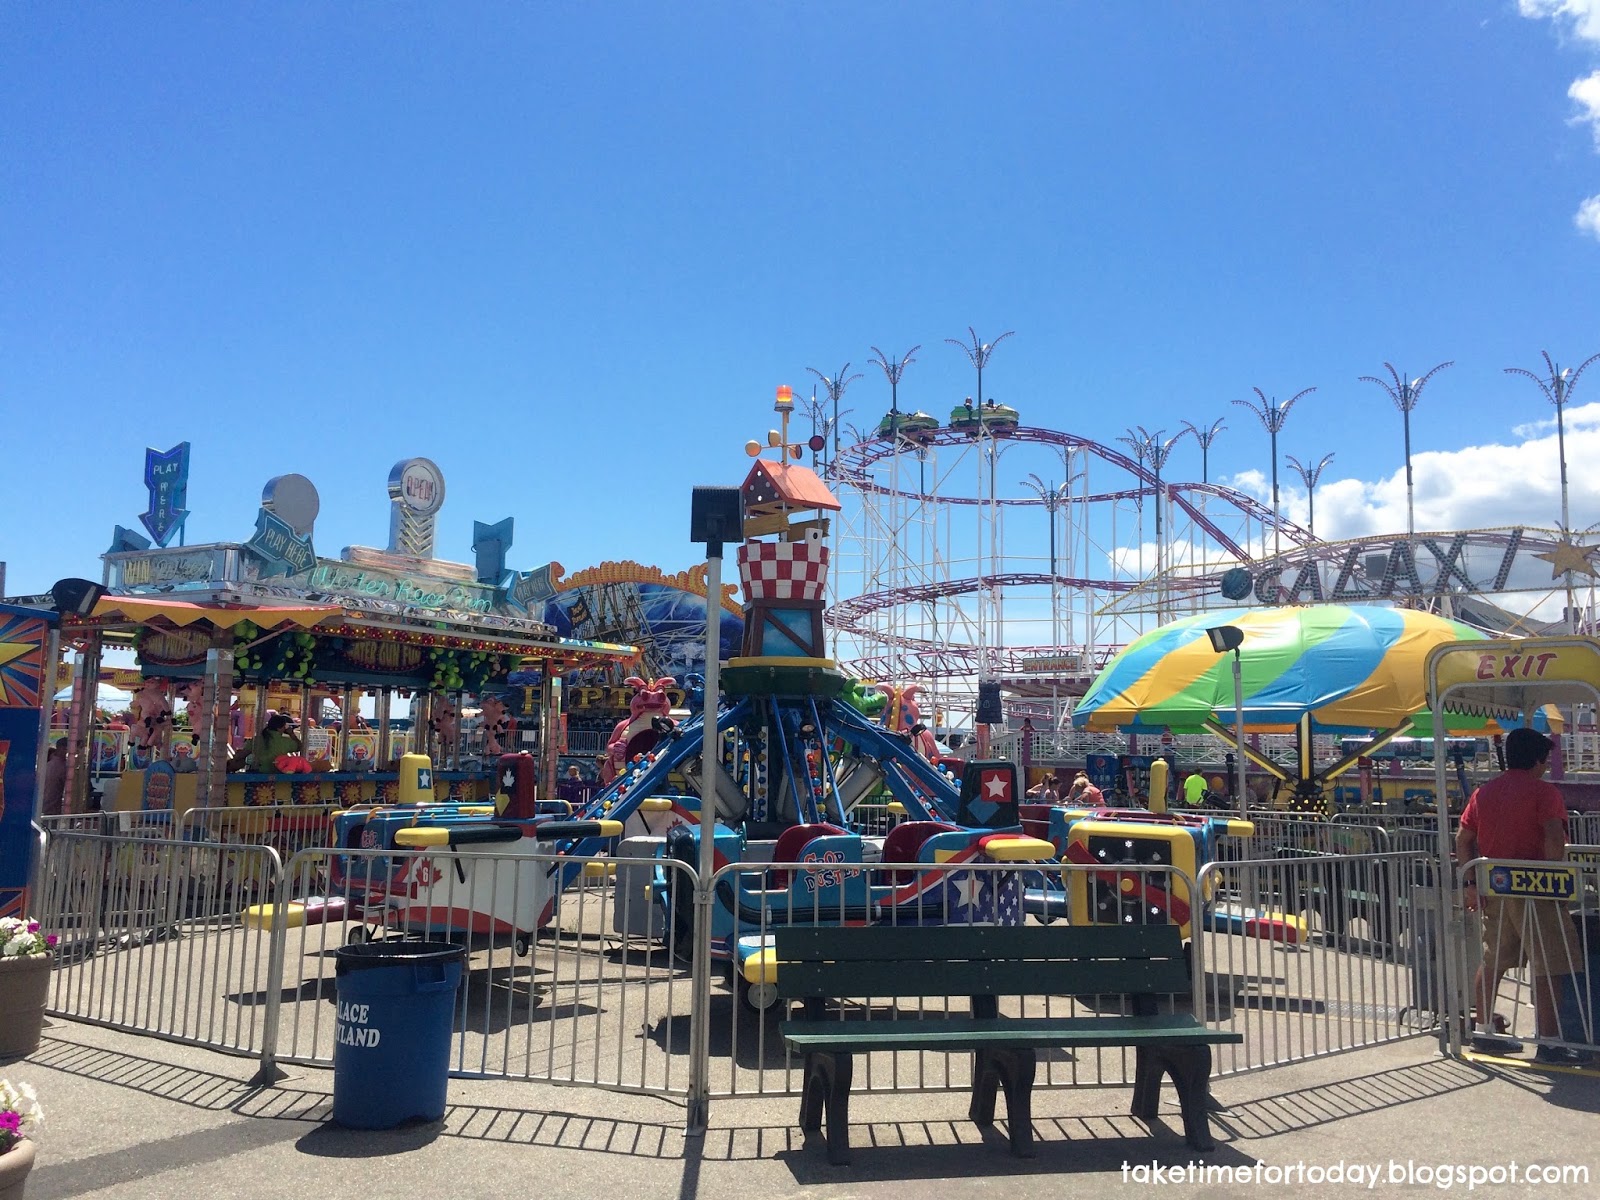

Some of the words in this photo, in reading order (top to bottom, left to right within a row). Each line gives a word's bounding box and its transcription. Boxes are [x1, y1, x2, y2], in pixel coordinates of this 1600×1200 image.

[153, 463, 178, 475] PLAY
[157, 482, 168, 532] HERE
[265, 528, 287, 552] PLAY
[284, 541, 311, 568] HERE
[310, 565, 390, 596] Water
[396, 579, 447, 607] Race
[1024, 658, 1077, 672] ENTRANCE
[1477, 652, 1558, 680] EXIT
[422, 866, 430, 883] 6
[1510, 870, 1570, 894] EXIT
